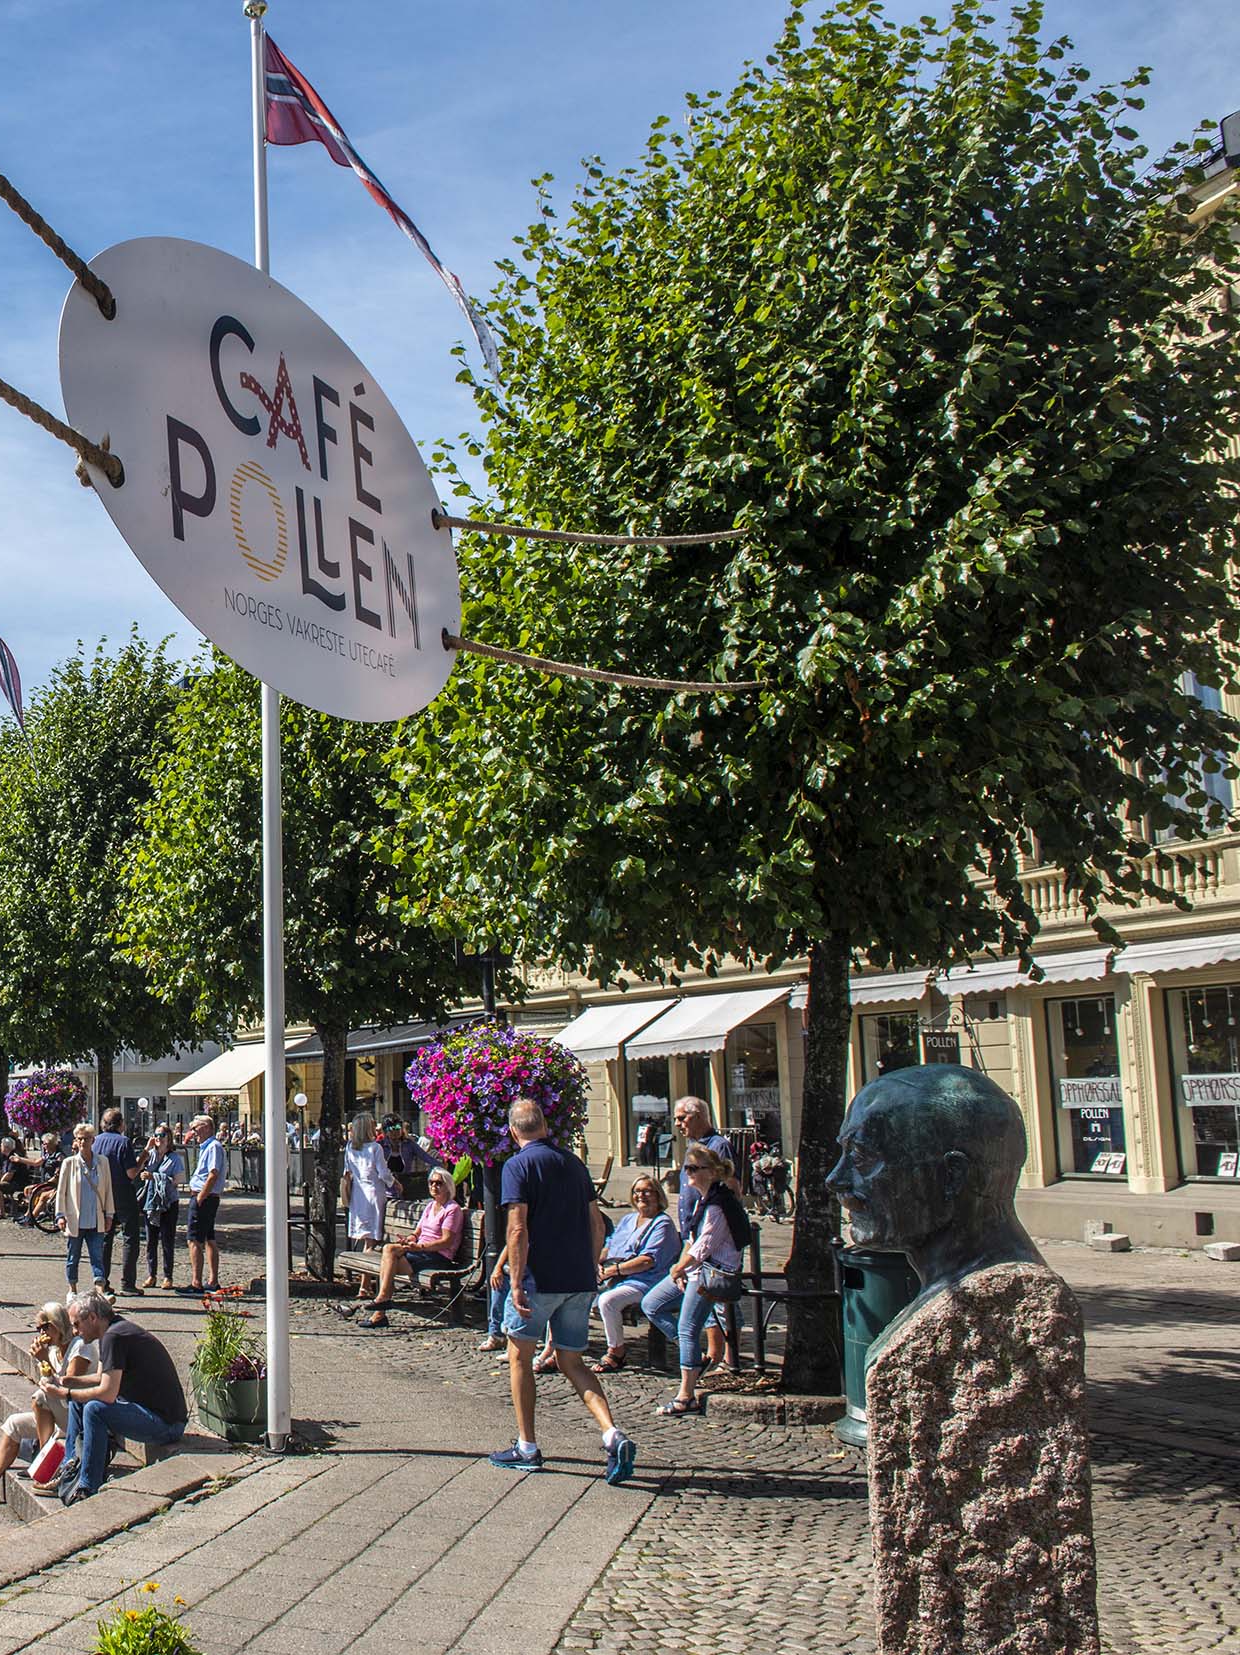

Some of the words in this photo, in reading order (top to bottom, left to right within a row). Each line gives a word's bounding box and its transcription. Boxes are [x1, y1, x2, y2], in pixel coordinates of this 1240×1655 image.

[209, 315, 383, 515] CAFÉ
[166, 414, 421, 650] POLLEN
[224, 587, 284, 631] NORGES
[286, 612, 346, 657] VAKRESTE
[348, 639, 397, 678] UTECAFÉ
[926, 1036, 957, 1048] POLLEN
[1081, 1108, 1109, 1119] POLLEN
